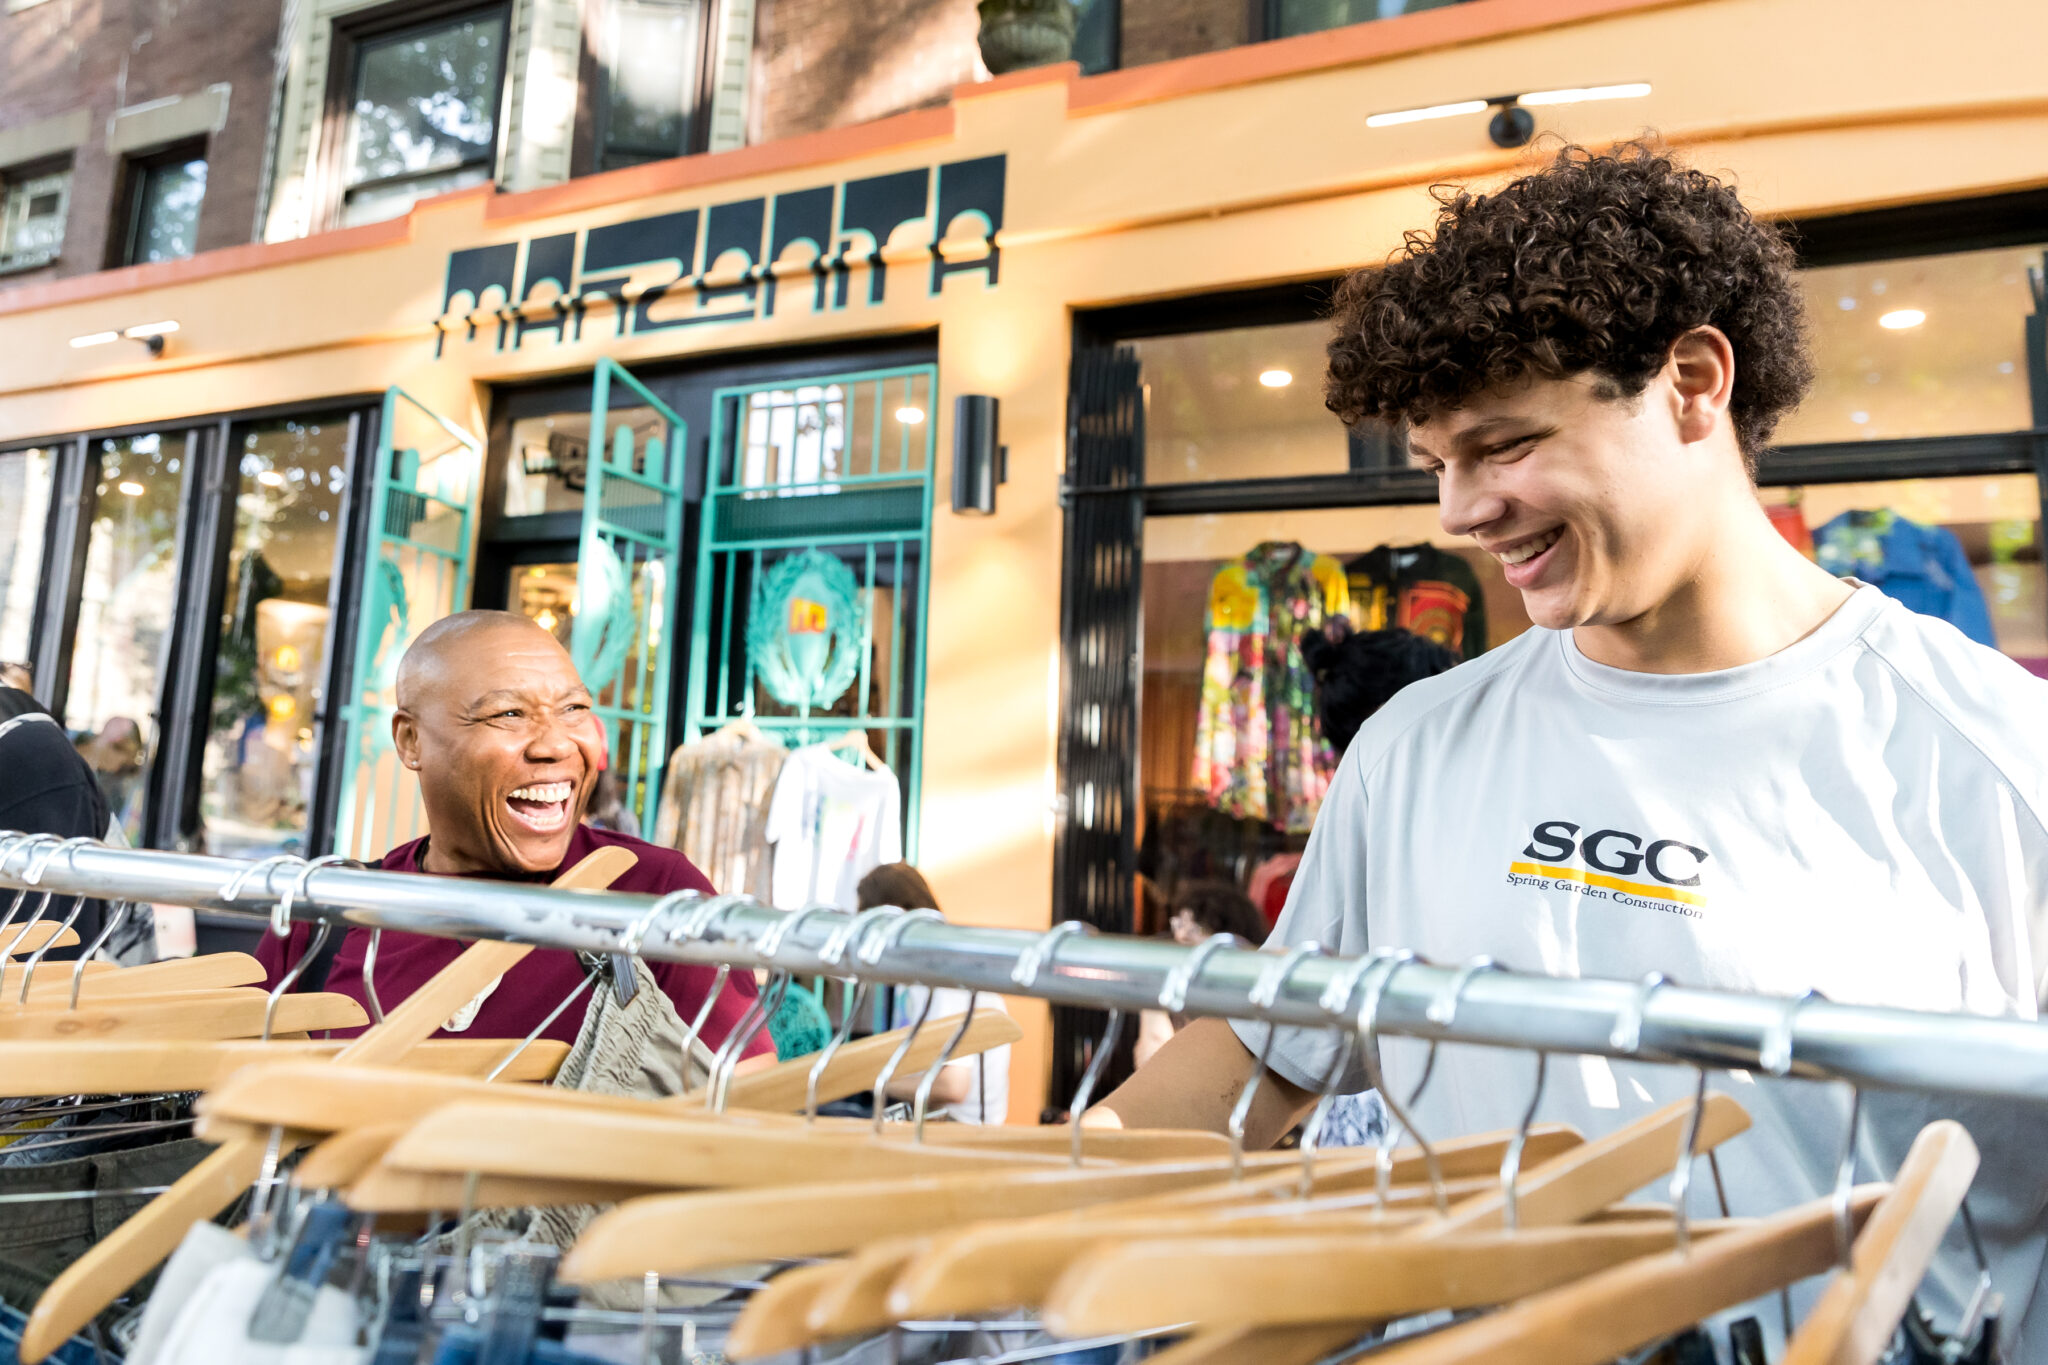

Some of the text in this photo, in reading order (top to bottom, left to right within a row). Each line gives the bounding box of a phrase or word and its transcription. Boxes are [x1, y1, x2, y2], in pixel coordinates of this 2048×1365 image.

[1522, 820, 1710, 887] SGC
[1506, 872, 1704, 920] Spring Garden Construction
